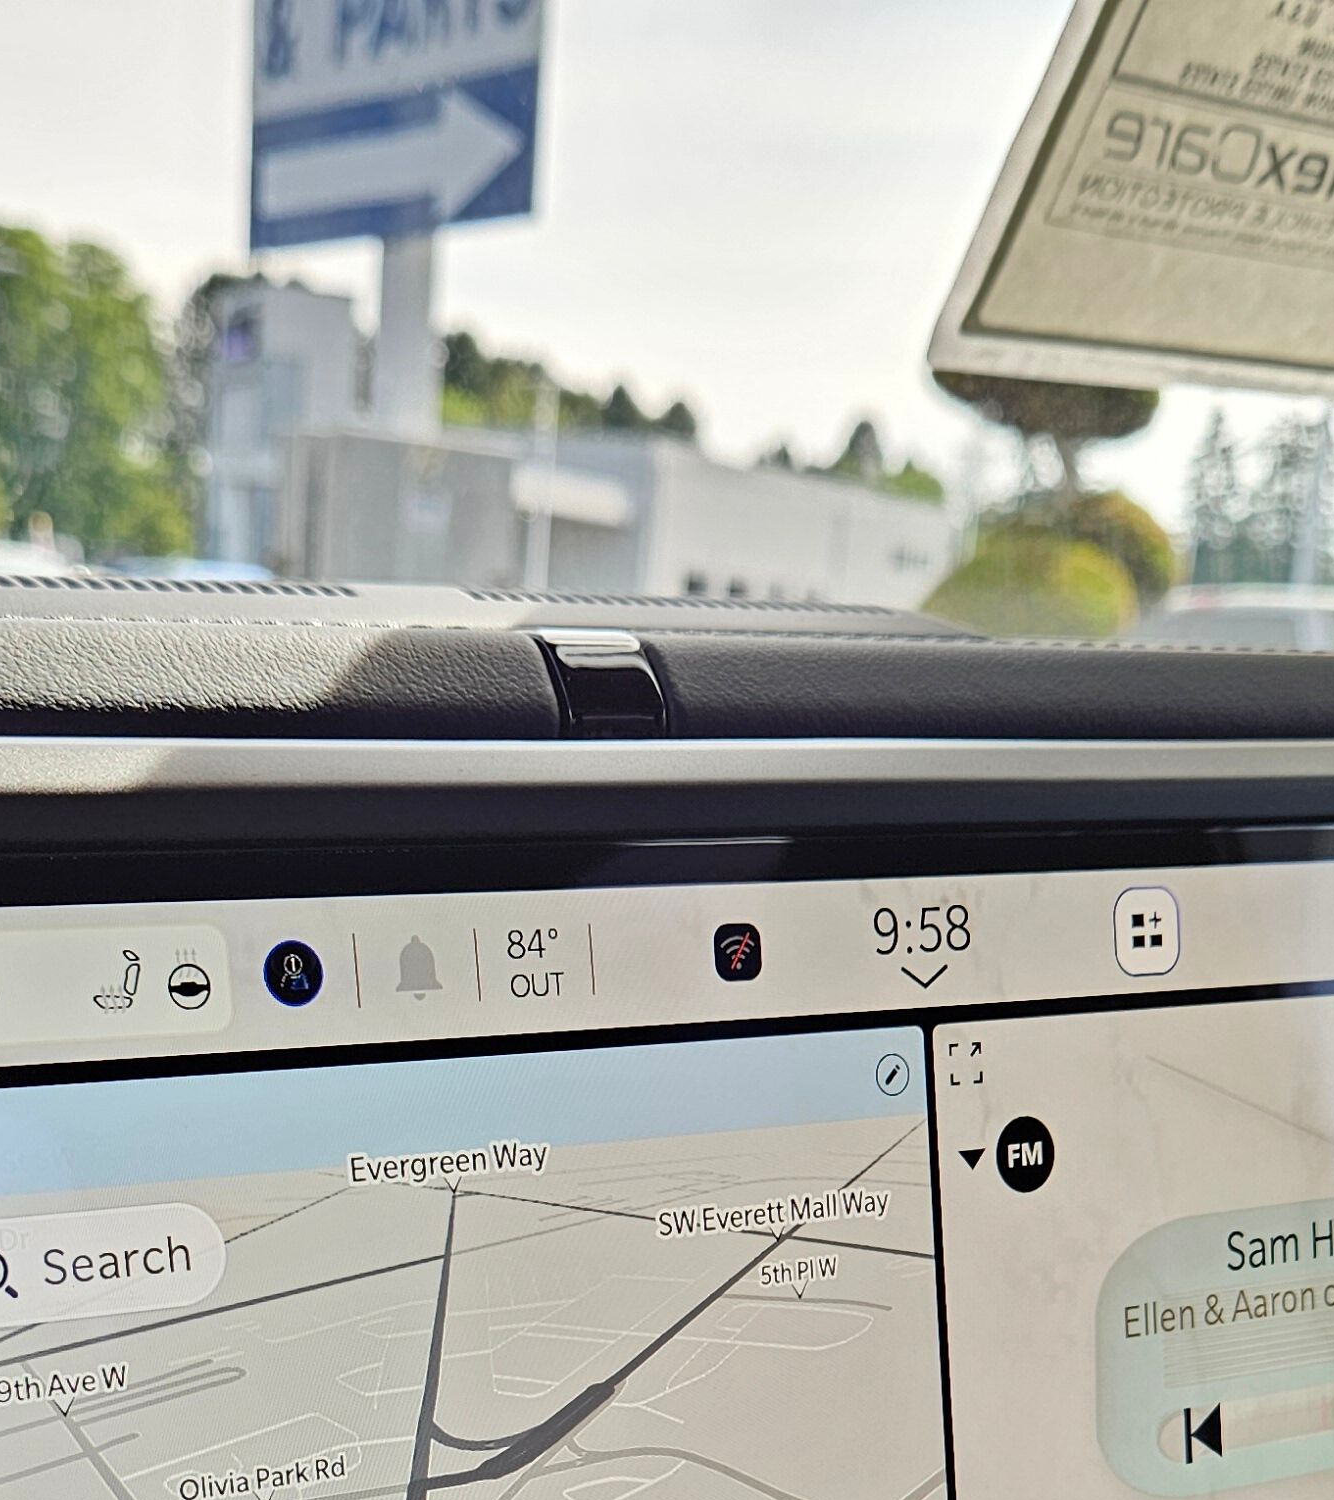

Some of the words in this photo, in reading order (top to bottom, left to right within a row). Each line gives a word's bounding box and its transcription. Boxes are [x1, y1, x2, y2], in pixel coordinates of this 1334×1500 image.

[506, 928, 558, 959] 84°
[872, 904, 971, 957] 9:58
[510, 972, 564, 998] OUT
[350, 1150, 487, 1186] Evergreen
[493, 1144, 547, 1172] Way
[1007, 1140, 1044, 1167] FM
[658, 1212, 696, 1236] SW
[702, 1203, 785, 1231] Everett
[791, 1195, 837, 1219] Mall
[841, 1191, 889, 1219] Way
[44, 1238, 191, 1285] Search
[1227, 1228, 1299, 1271] Sam
[761, 1262, 792, 1286] 5th
[796, 1260, 814, 1281] Pl
[817, 1258, 837, 1279] W
[1124, 1301, 1195, 1338] Ellen
[1204, 1298, 1225, 1325] &
[1232, 1289, 1314, 1322] Aaron
[48, 1374, 96, 1396] Ave
[101, 1367, 127, 1388] W
[179, 1474, 249, 1500] Olivia
[256, 1467, 309, 1489] Park
[316, 1457, 346, 1481] Rd
